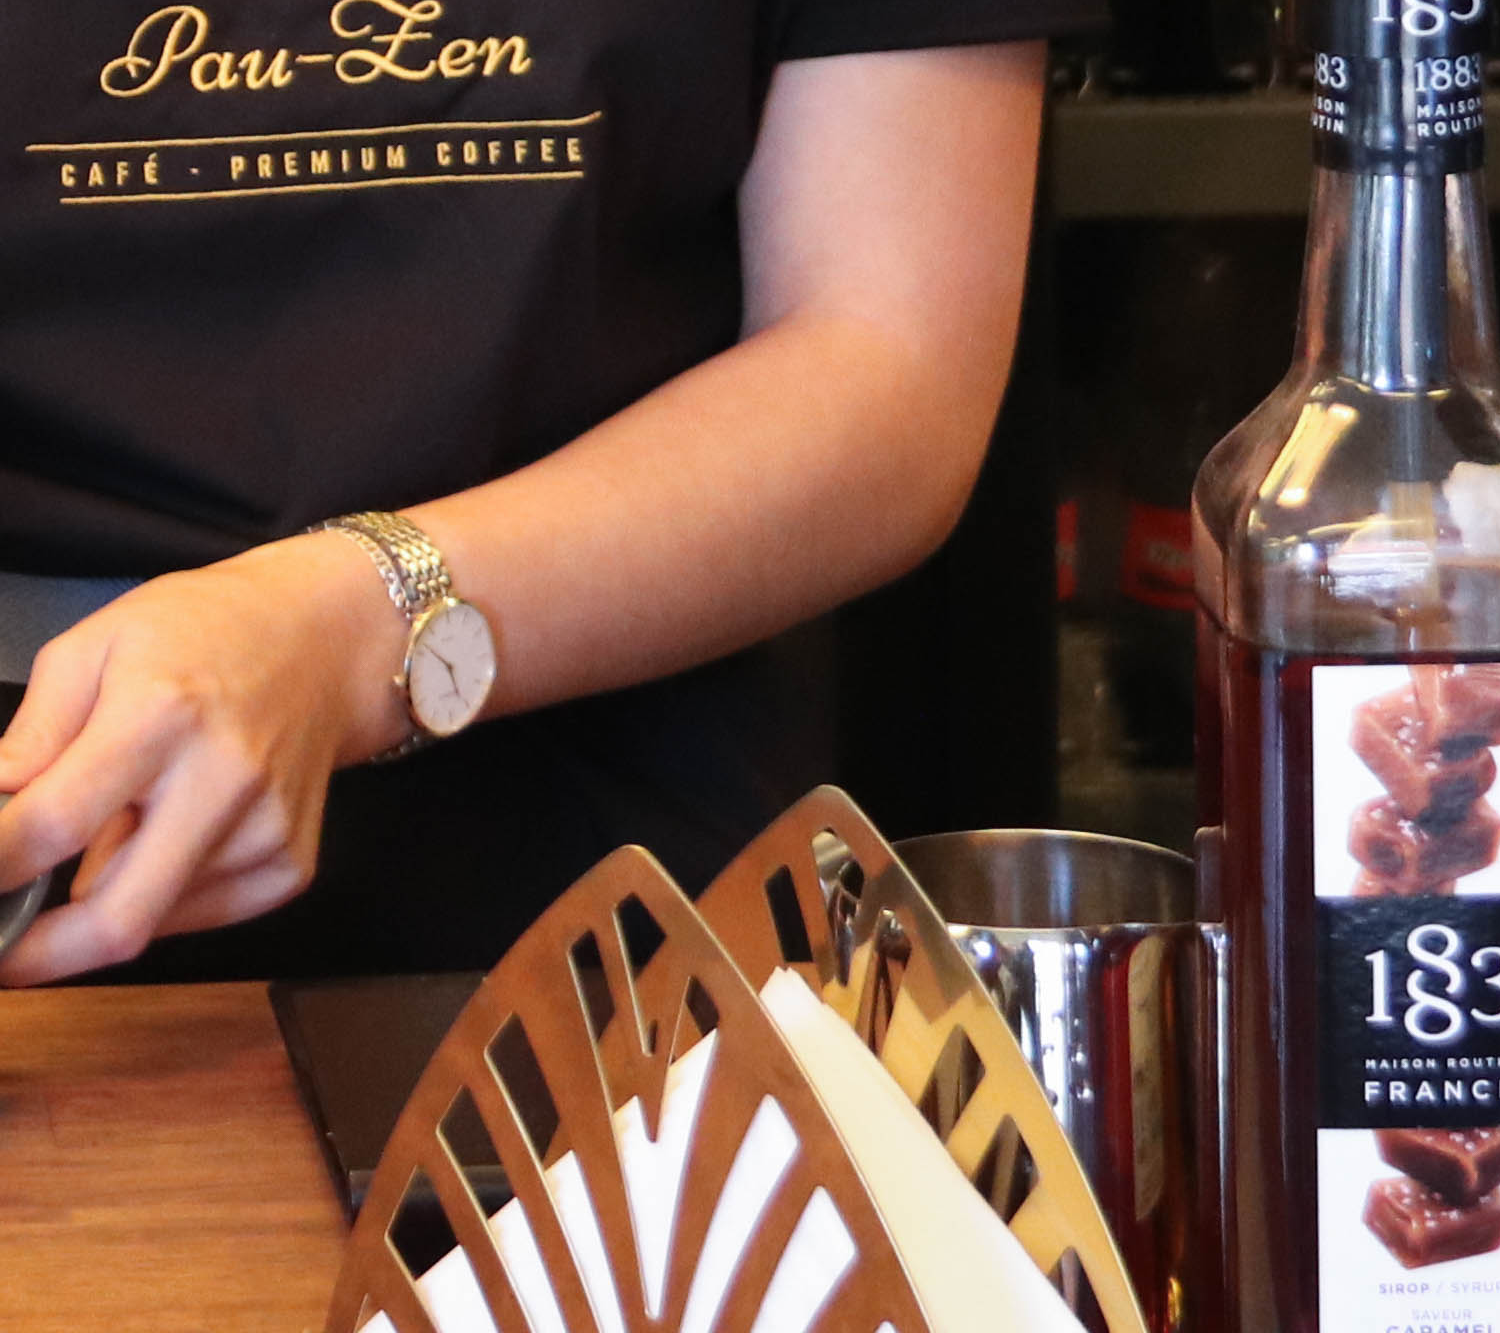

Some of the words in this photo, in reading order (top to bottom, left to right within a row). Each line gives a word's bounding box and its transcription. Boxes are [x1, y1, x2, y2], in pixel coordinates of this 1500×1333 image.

[1315, 52, 1347, 89] 83
[1315, 95, 1345, 116] SON
[60, 152, 160, 188] CAFÉ
[230, 143, 407, 183] PREMIUM
[436, 136, 584, 167] COFFEE
[1365, 1057, 1436, 1070] MAISON
[1378, 1282, 1430, 1295] SIROP
